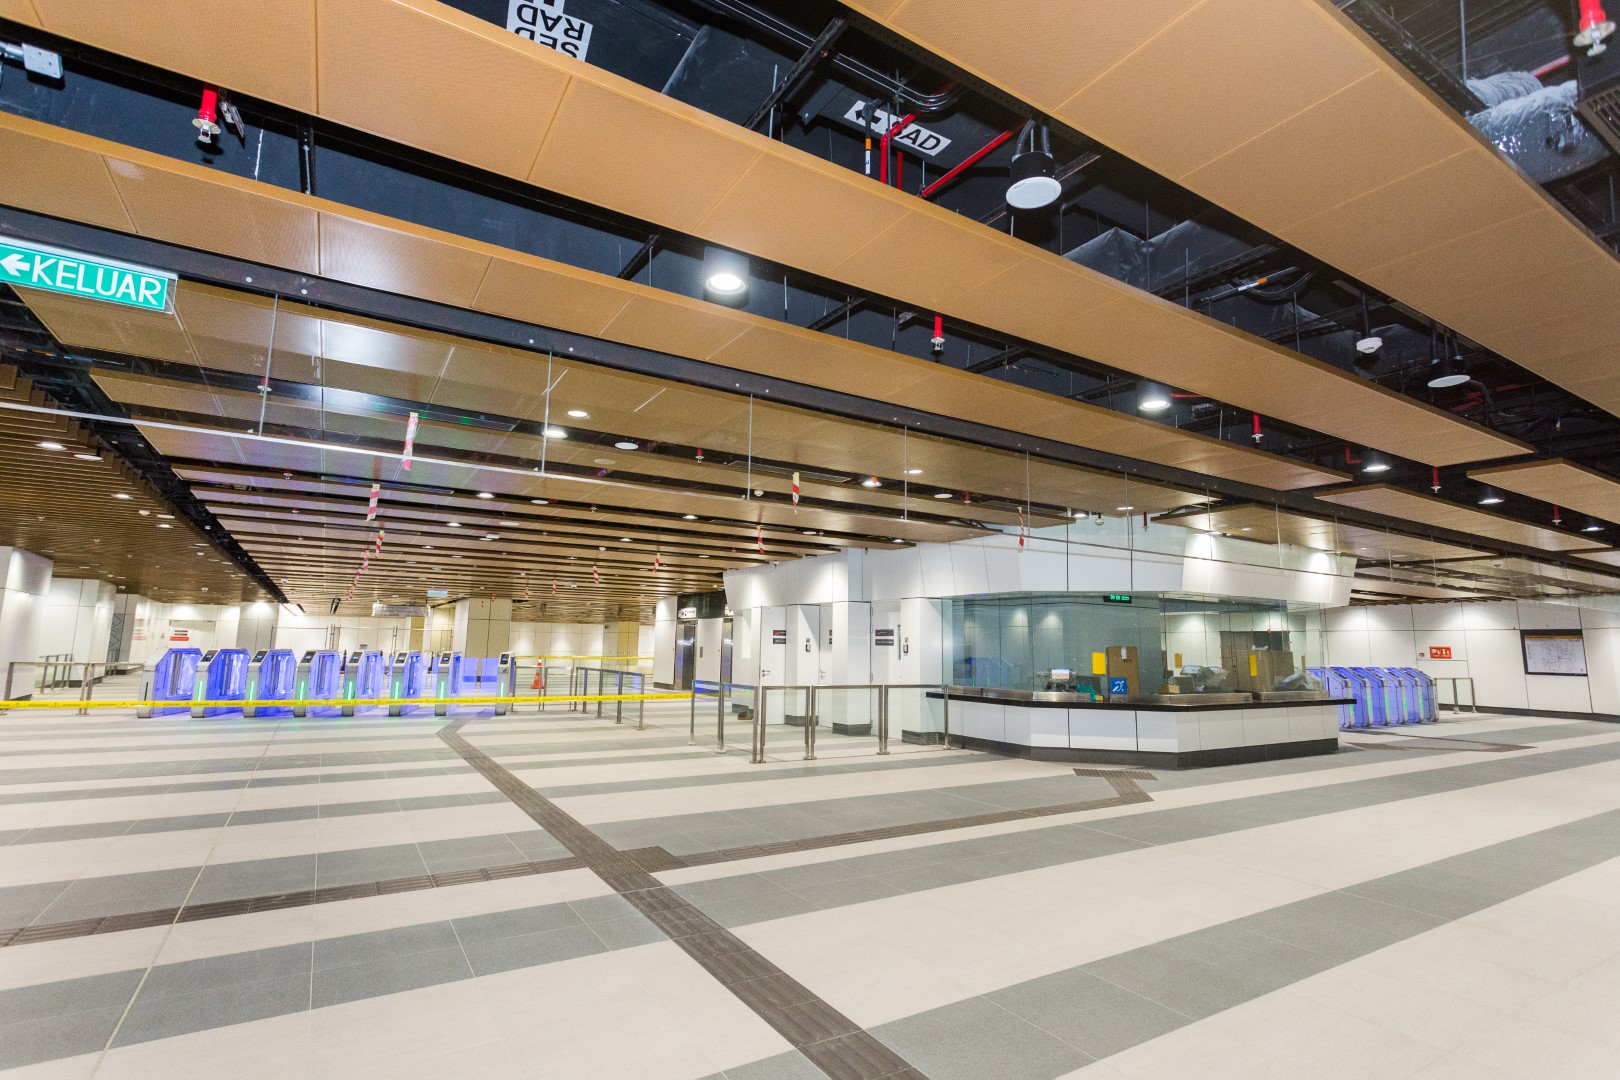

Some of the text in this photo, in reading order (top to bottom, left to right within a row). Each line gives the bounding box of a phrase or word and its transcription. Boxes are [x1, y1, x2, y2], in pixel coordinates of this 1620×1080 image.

[516, 4, 586, 41] RAD
[887, 121, 941, 150] AD
[32, 255, 161, 305] KELUAR
